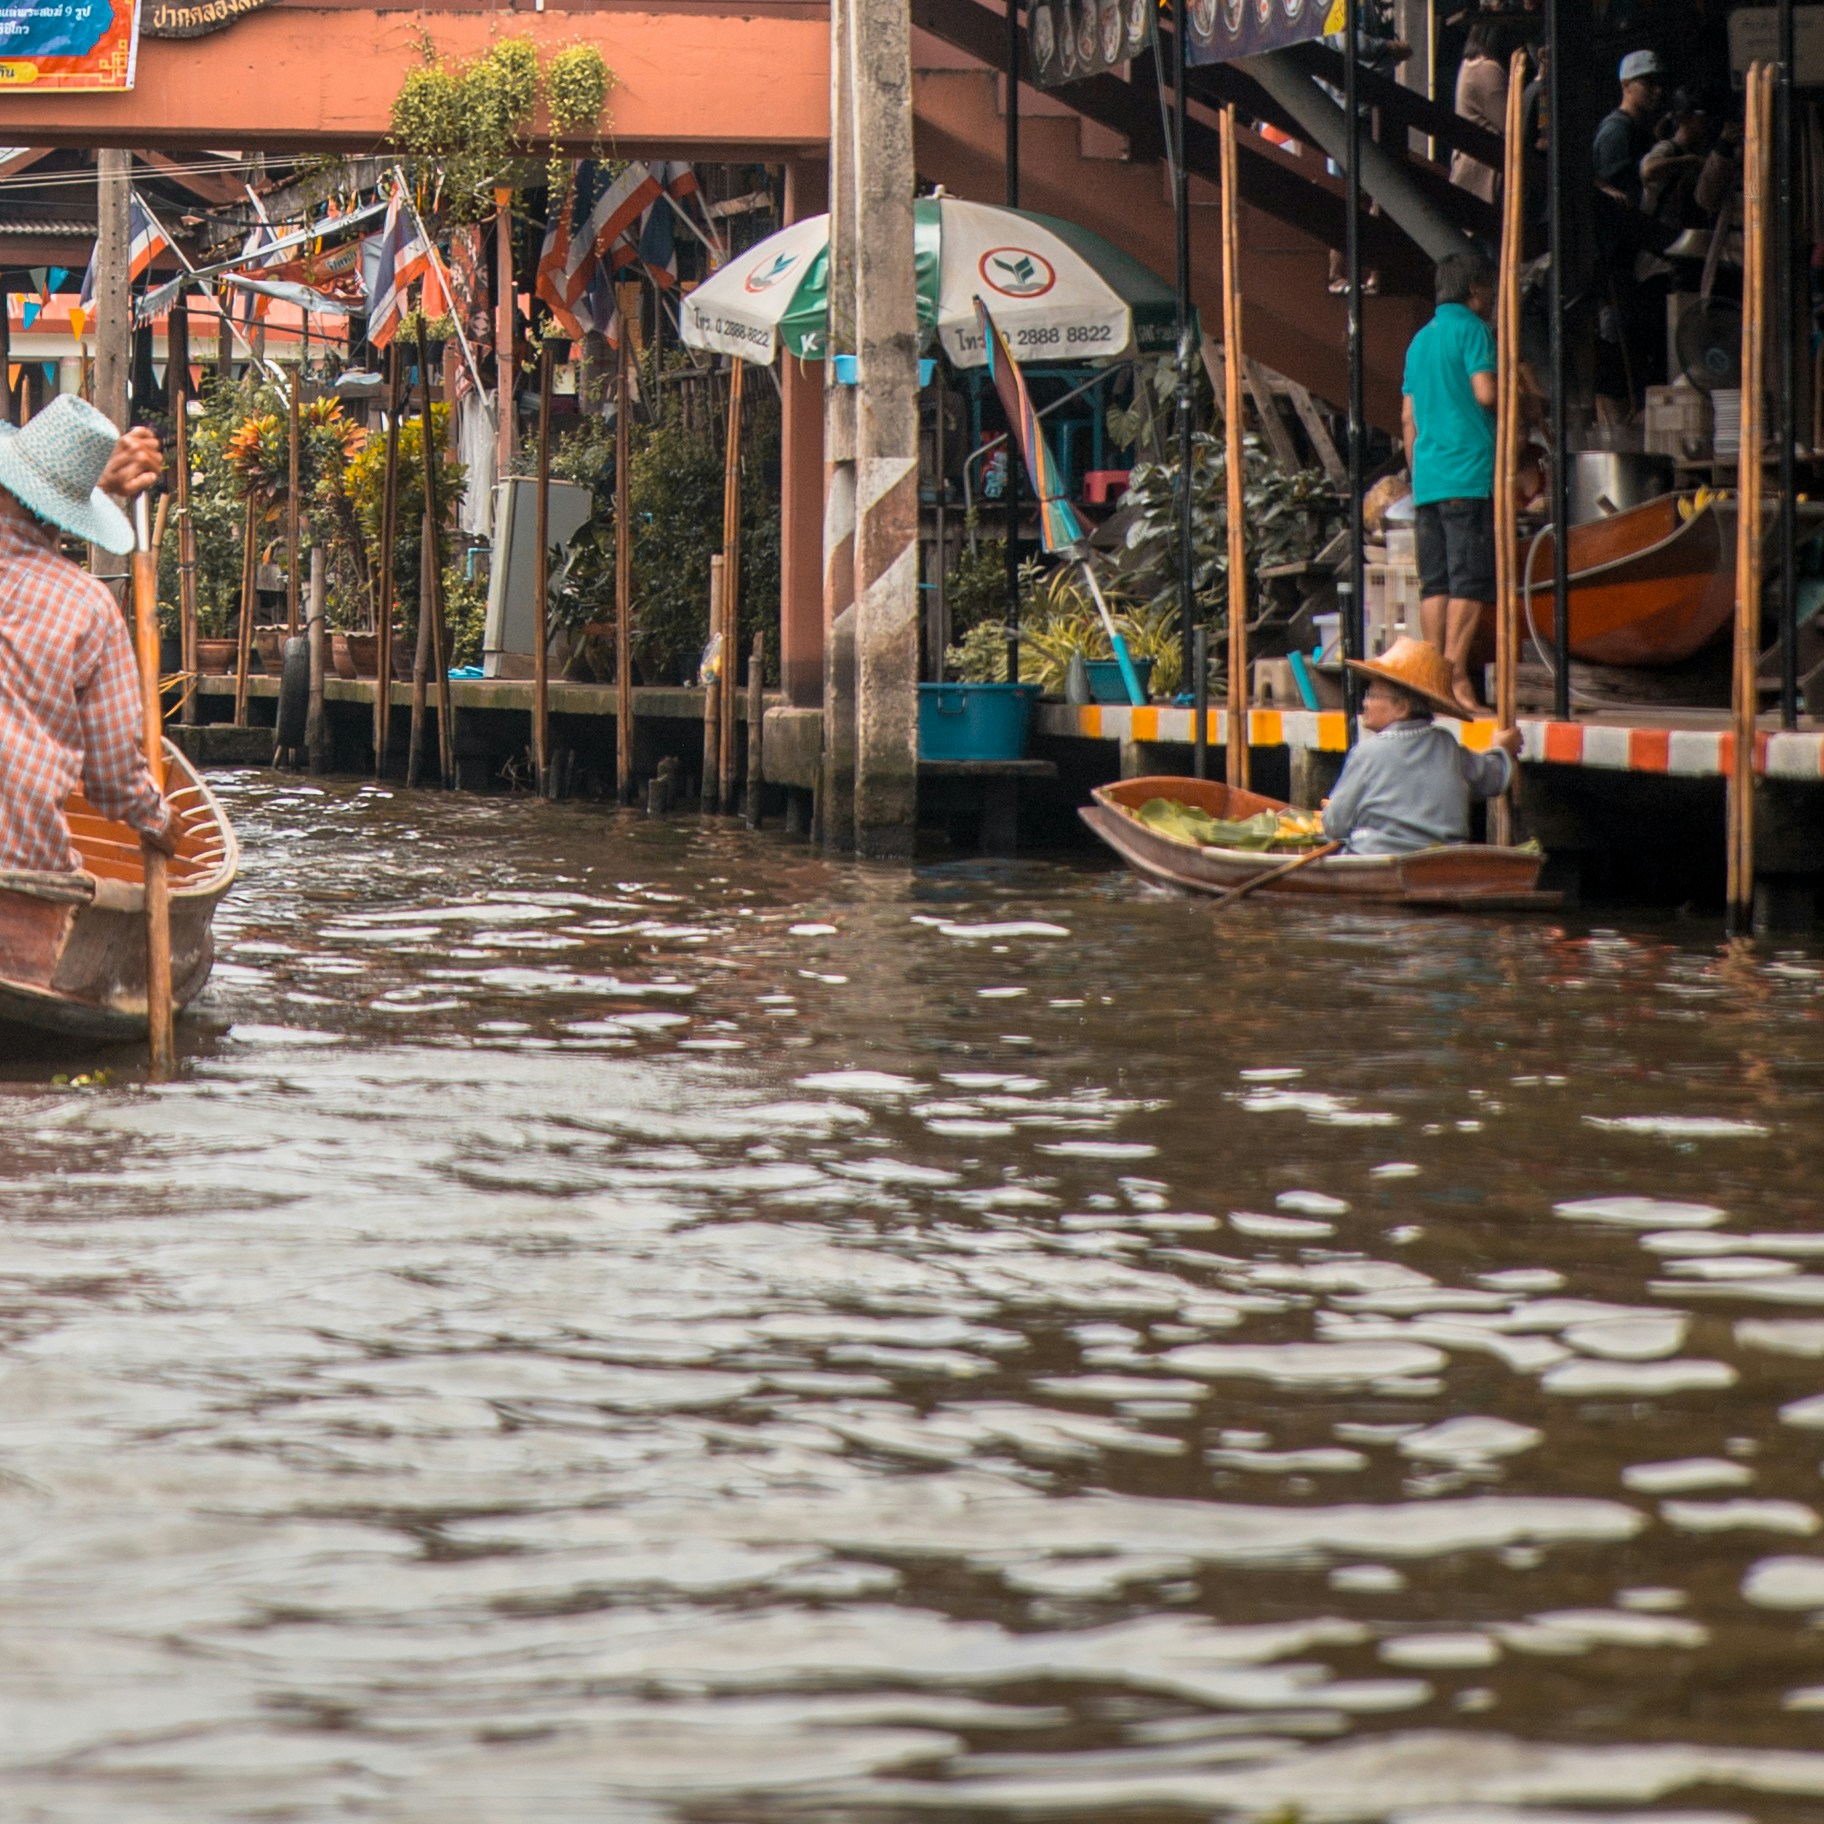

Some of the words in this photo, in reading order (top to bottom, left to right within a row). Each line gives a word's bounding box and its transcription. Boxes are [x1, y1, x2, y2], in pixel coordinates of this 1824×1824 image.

[65, 7, 73, 18] 9
[1017, 325, 1061, 346] 2888
[1066, 325, 1112, 343] 8822
